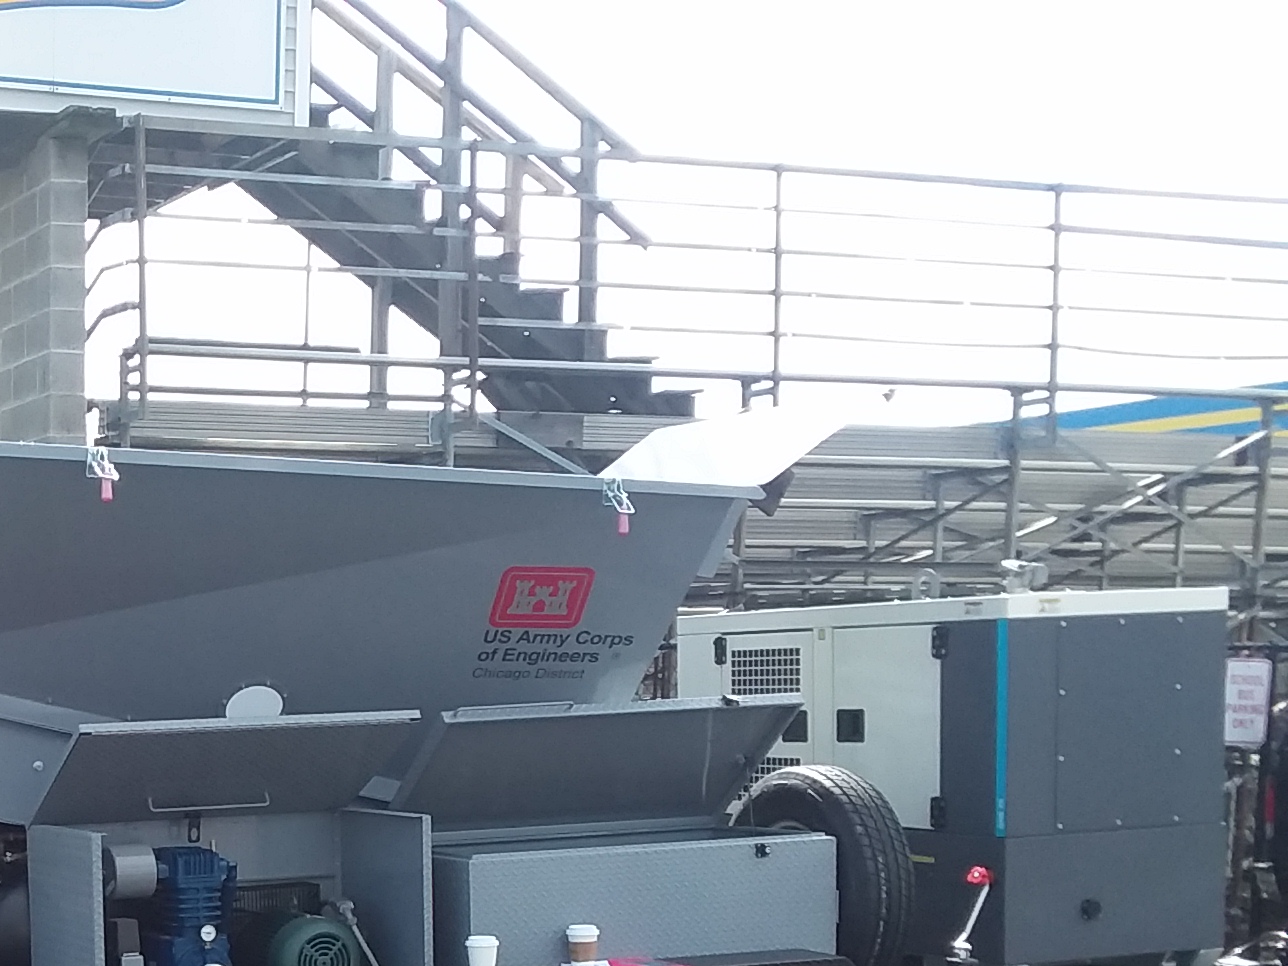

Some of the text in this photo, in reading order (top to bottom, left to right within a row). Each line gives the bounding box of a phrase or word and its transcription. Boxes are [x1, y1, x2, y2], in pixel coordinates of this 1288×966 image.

[483, 630, 634, 649] US Army Corps
[477, 648, 600, 665] of Engineers
[472, 667, 585, 681] Chicago District
